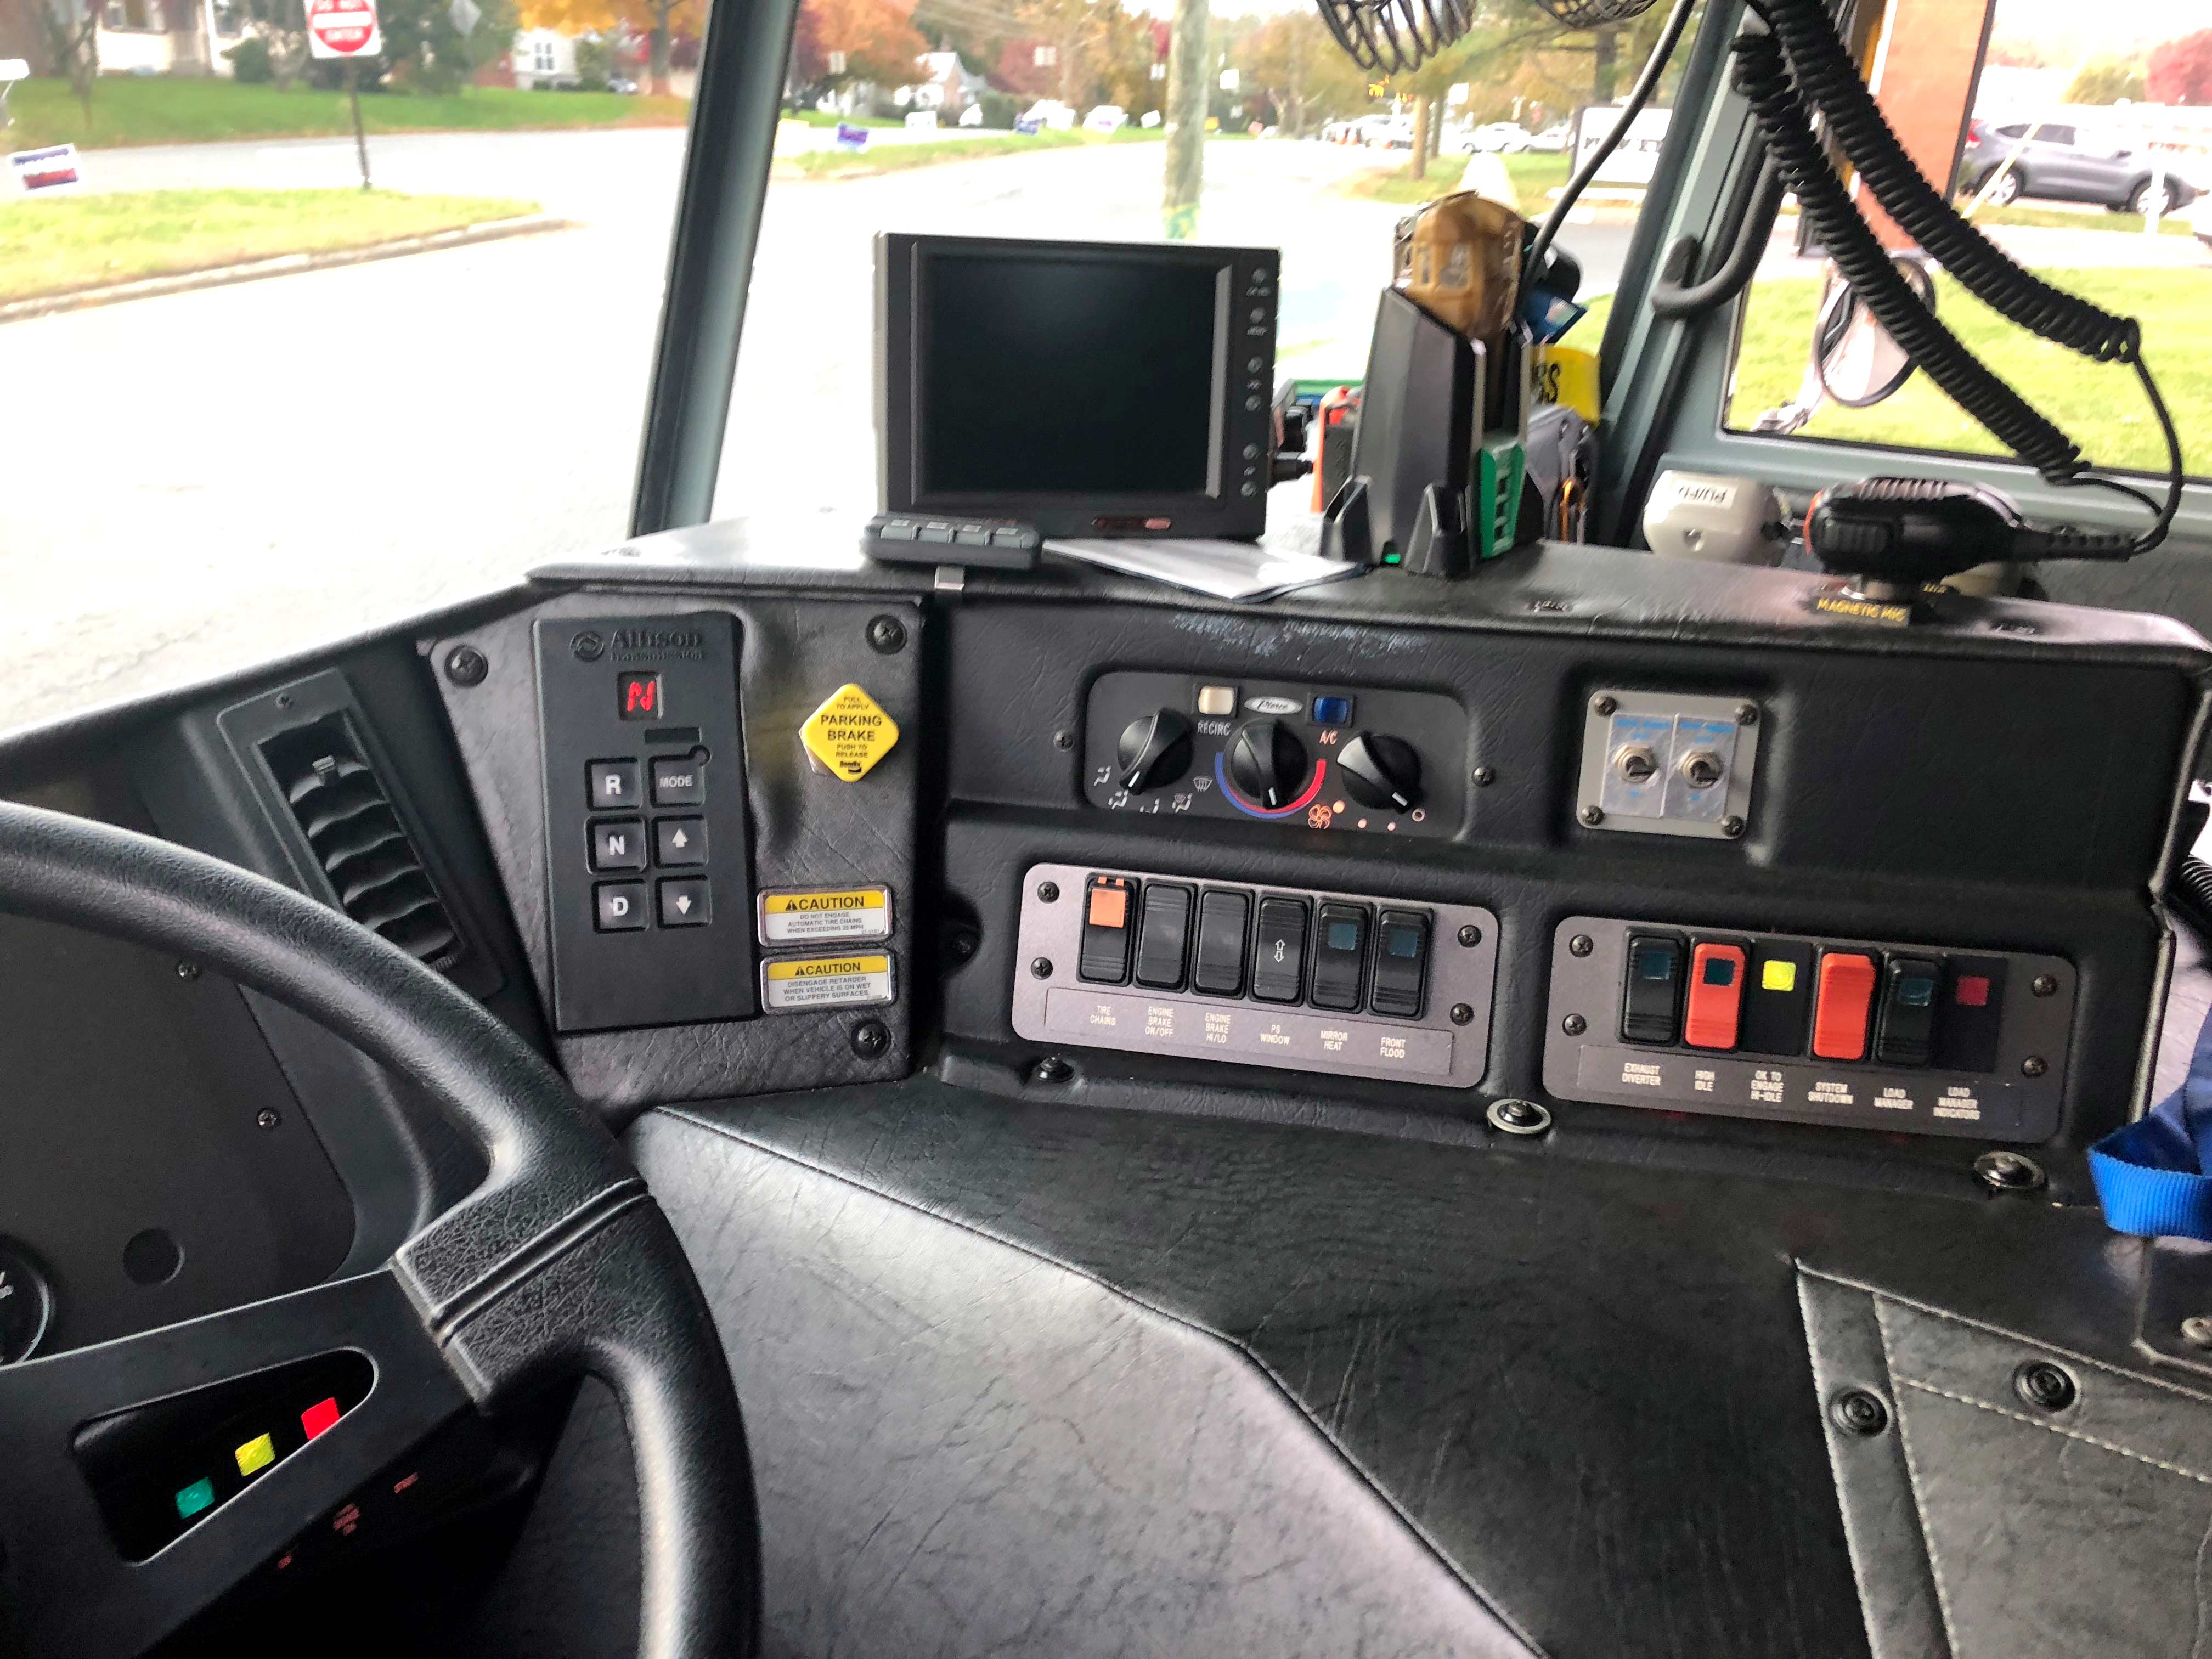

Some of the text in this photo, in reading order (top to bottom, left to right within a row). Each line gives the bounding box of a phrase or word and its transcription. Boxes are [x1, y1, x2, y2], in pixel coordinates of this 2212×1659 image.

[1816, 598, 1907, 622] MAGNETIC MIC
[610, 629, 702, 648] Allison
[820, 714, 882, 727] PARKING
[1197, 720, 1231, 736] RECIRC
[827, 730, 876, 742] BRAKE
[1319, 729, 1339, 746] A/C
[605, 774, 621, 794] R
[659, 775, 693, 788] MODE
[608, 834, 625, 855] N
[613, 896, 629, 917] D
[799, 896, 865, 910] CAUTION
[806, 962, 860, 975] CAUTION
[787, 976, 866, 988] DISENGAGE RETARDER
[797, 993, 830, 1001] SLIPPERY
[1097, 1005, 1111, 1015] TIRE
[1148, 1006, 1173, 1018] ENGINE
[1090, 1015, 1116, 1026] CHAINS
[1148, 1017, 1172, 1028] BRAKE
[1205, 1012, 1231, 1024] ENGINE
[1145, 1026, 1173, 1037] ON/OFF
[1205, 1023, 1229, 1034] BRAKE
[1271, 1024, 1281, 1034] PS
[1206, 1033, 1227, 1043] HI/LO
[1260, 1033, 1290, 1045] WINDOW
[1321, 1030, 1348, 1042] MIRROR
[1324, 1041, 1342, 1051] HEAT
[1381, 1037, 1406, 1048] FRONT
[1380, 1047, 1406, 1059] FLOOD
[1624, 1063, 1660, 1075] EXHAUST
[1622, 1073, 1661, 1086] DIVERTER
[1695, 1070, 1715, 1081] HIGH
[1771, 1071, 1782, 1081] TO
[1694, 1080, 1714, 1092] IDLE
[1751, 1079, 1784, 1092] ENGAGE
[1815, 1081, 1848, 1093] SYSTEM
[1808, 1091, 1853, 1104] SHUTDOWN
